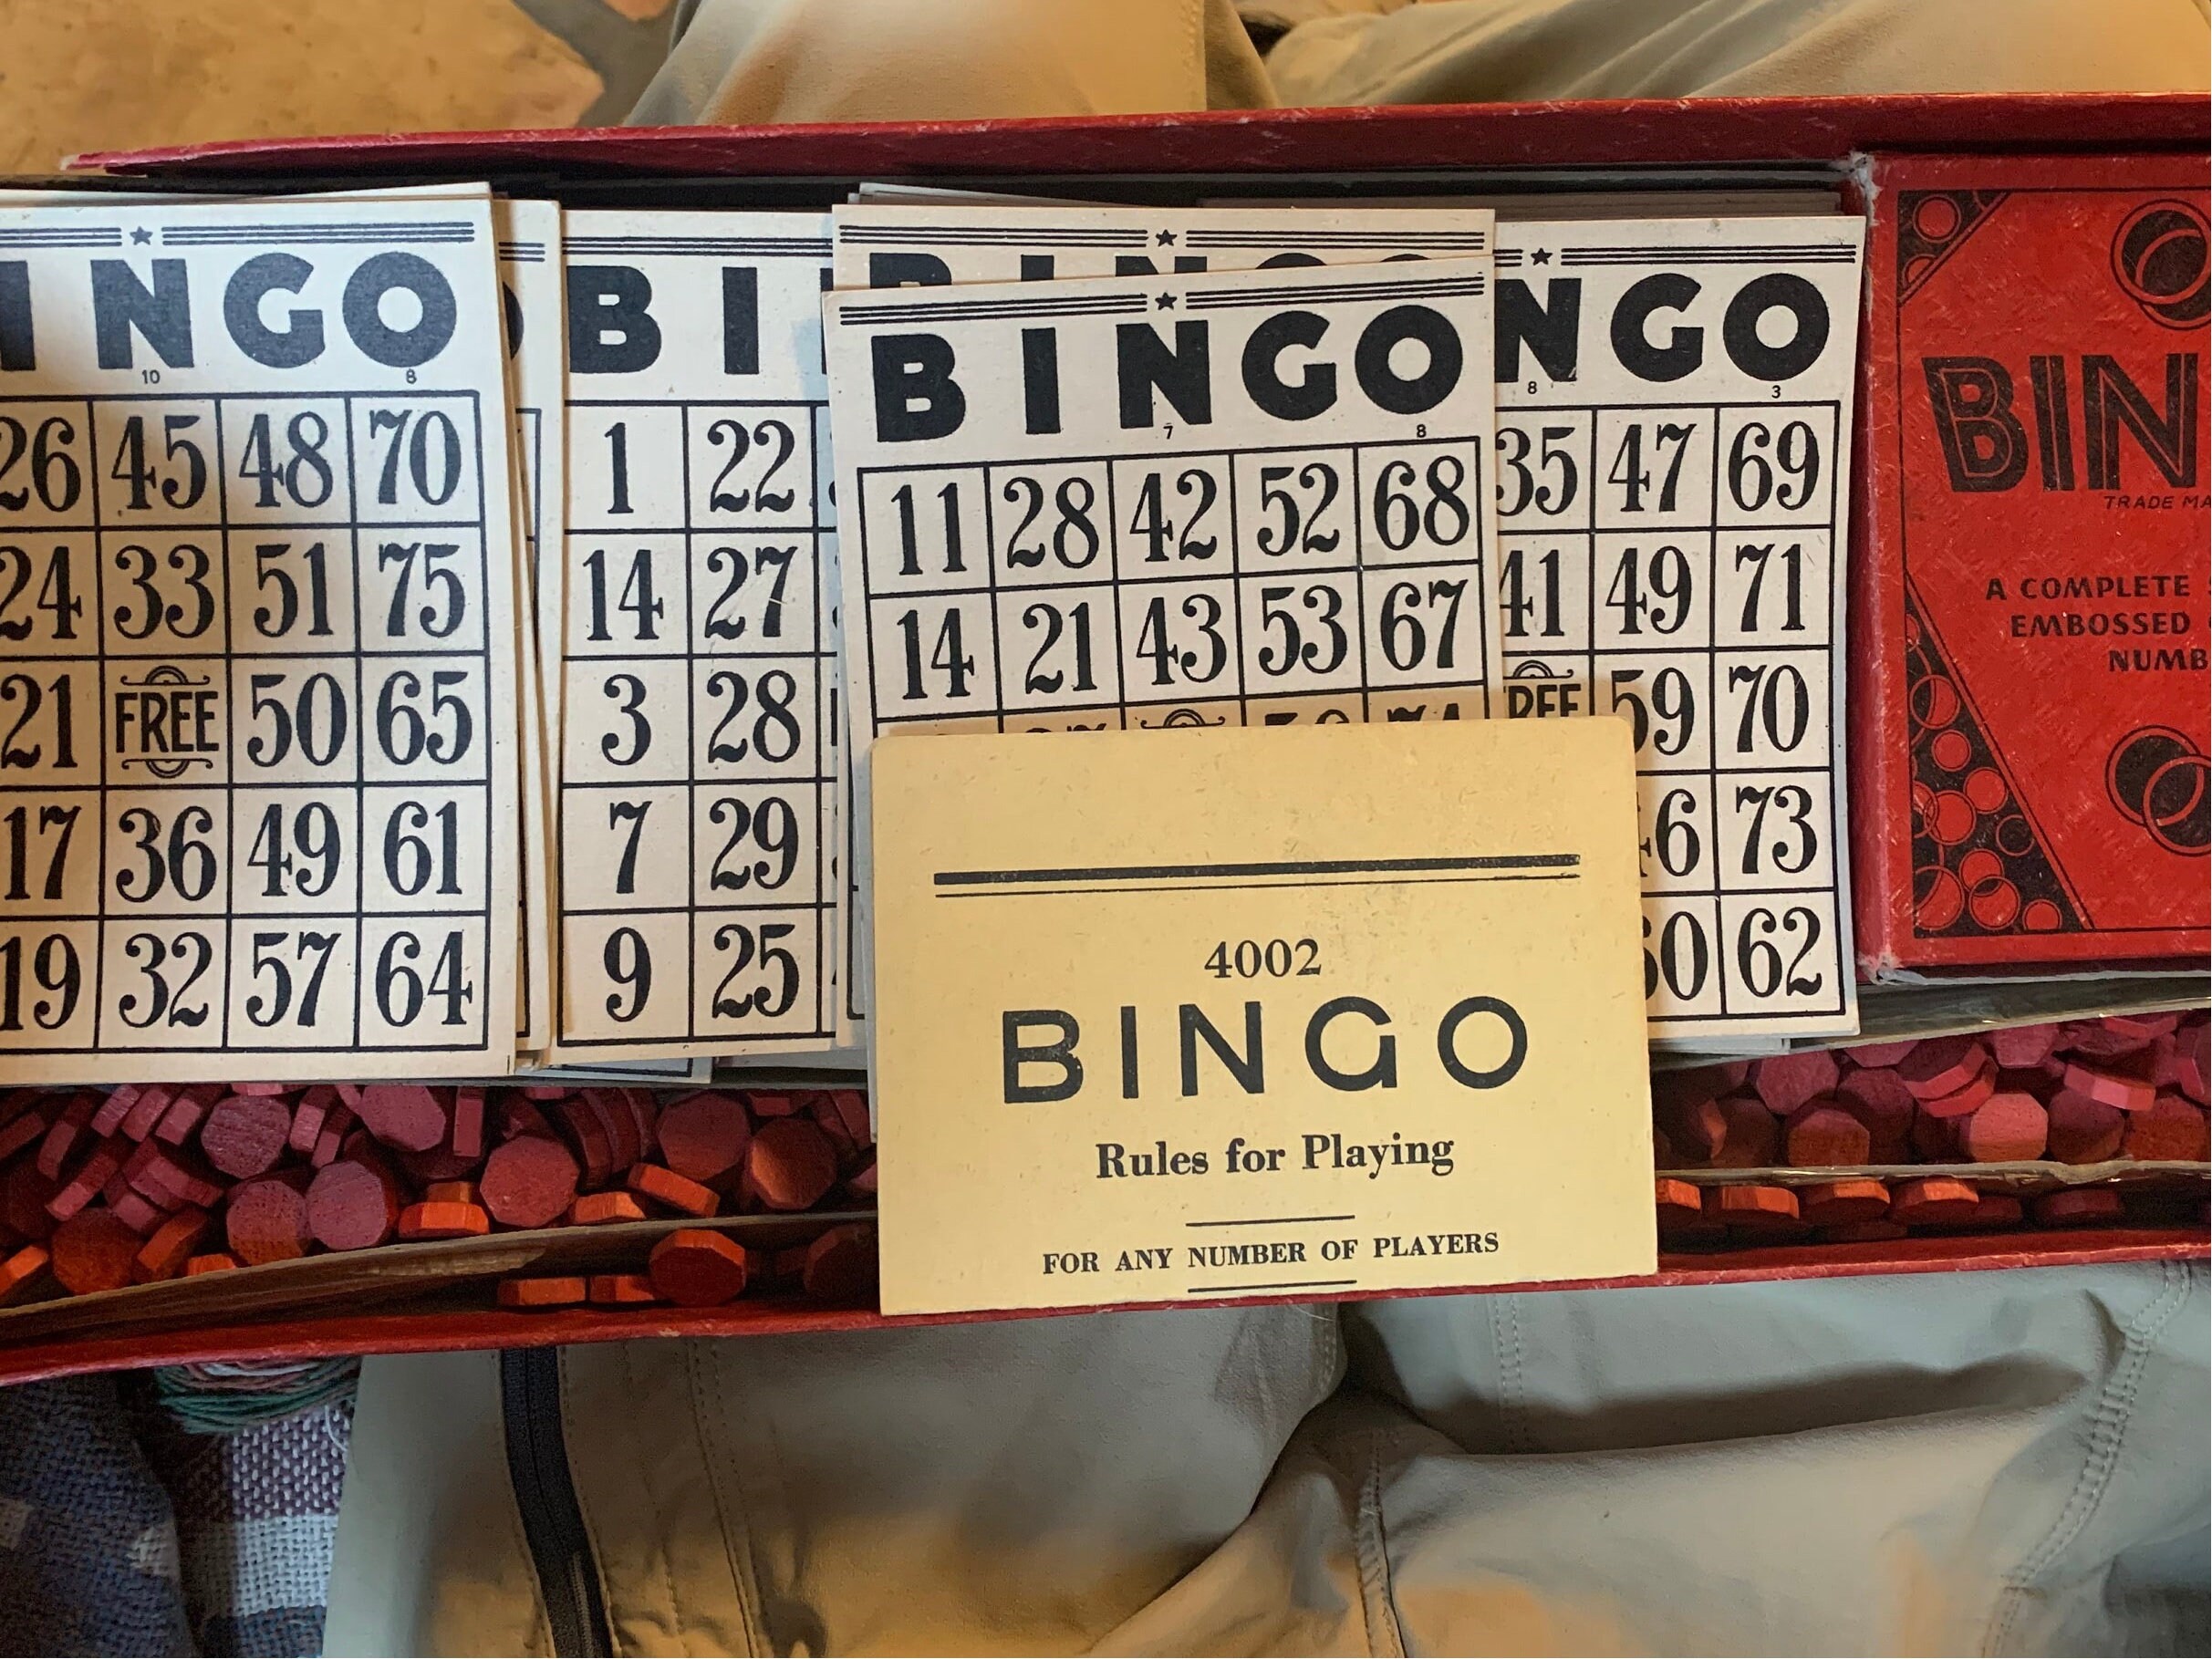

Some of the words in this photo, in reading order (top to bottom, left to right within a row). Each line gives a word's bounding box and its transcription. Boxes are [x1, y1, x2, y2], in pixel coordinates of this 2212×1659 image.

[872, 305, 1463, 442] BINGO
[1495, 273, 1830, 382] NGO
[142, 370, 160, 384] 10
[406, 368, 417, 384] 8
[1528, 381, 1537, 394] 8
[1772, 385, 1781, 399] 3
[1921, 352, 2198, 493] BIN
[0, 417, 80, 512] 26
[111, 416, 206, 510] 45
[239, 411, 333, 508] 48
[369, 410, 461, 505] 70
[605, 422, 634, 513] 1
[708, 420, 794, 512] 22
[1164, 426, 1173, 439] 7
[1417, 424, 1426, 438] 8
[1496, 427, 1577, 516] 35
[1608, 423, 1697, 513] 47
[1729, 421, 1819, 511] 69
[891, 482, 967, 575] 11
[1004, 477, 1099, 569] 28
[1130, 470, 1217, 562] 42
[1257, 463, 1339, 556] 52
[1374, 455, 1469, 550] 68
[2104, 495, 2175, 509] TRADE
[0, 546, 82, 640] 24
[114, 544, 214, 639] 33
[254, 543, 333, 638] 51
[379, 543, 465, 638] 75
[583, 549, 663, 640] 14
[704, 546, 798, 640] 27
[1500, 549, 1564, 637] 41
[1605, 545, 1692, 634] 49
[1736, 544, 1805, 632] 71
[1986, 578, 2007, 600] A
[2020, 575, 2190, 599] COMPLETE
[2011, 611, 2190, 638] EMBOSSED
[897, 608, 974, 700] 14
[1023, 602, 1097, 694] 21
[1137, 594, 1227, 685] 43
[1259, 586, 1347, 676] 53
[1380, 579, 1468, 670] 67
[2109, 648, 2208, 672] NUMB
[0, 674, 78, 769] 21
[115, 691, 219, 753] FREE
[247, 673, 347, 767] 50
[377, 670, 472, 765] 65
[602, 674, 651, 765] 3
[707, 669, 800, 763] 28
[1612, 668, 1694, 755] 59
[1729, 665, 1809, 752] 70
[4, 805, 81, 900] 17
[116, 806, 216, 902] 36
[247, 802, 340, 897] 49
[384, 801, 462, 896] 61
[610, 801, 652, 894] 7
[710, 797, 798, 890] 29
[1736, 785, 1817, 874] 73
[0, 934, 80, 1031] 19
[119, 932, 212, 1028] 32
[246, 932, 341, 1027] 57
[376, 931, 473, 1027] 64
[604, 928, 651, 1022] 9
[712, 924, 799, 1019] 25
[1205, 938, 1321, 978] 4002
[1738, 907, 1822, 998] 62
[1002, 996, 1527, 1104] BINGO
[1096, 1141, 1209, 1178] Rules
[1226, 1138, 1285, 1173] for
[1302, 1133, 1454, 1179] Playing
[1044, 1252, 1099, 1274] FOR
[1116, 1248, 1173, 1271] ANY
[1188, 1243, 1306, 1267] NUMBER
[1322, 1239, 1357, 1260] OF
[1374, 1232, 1499, 1258] PLAYERS
